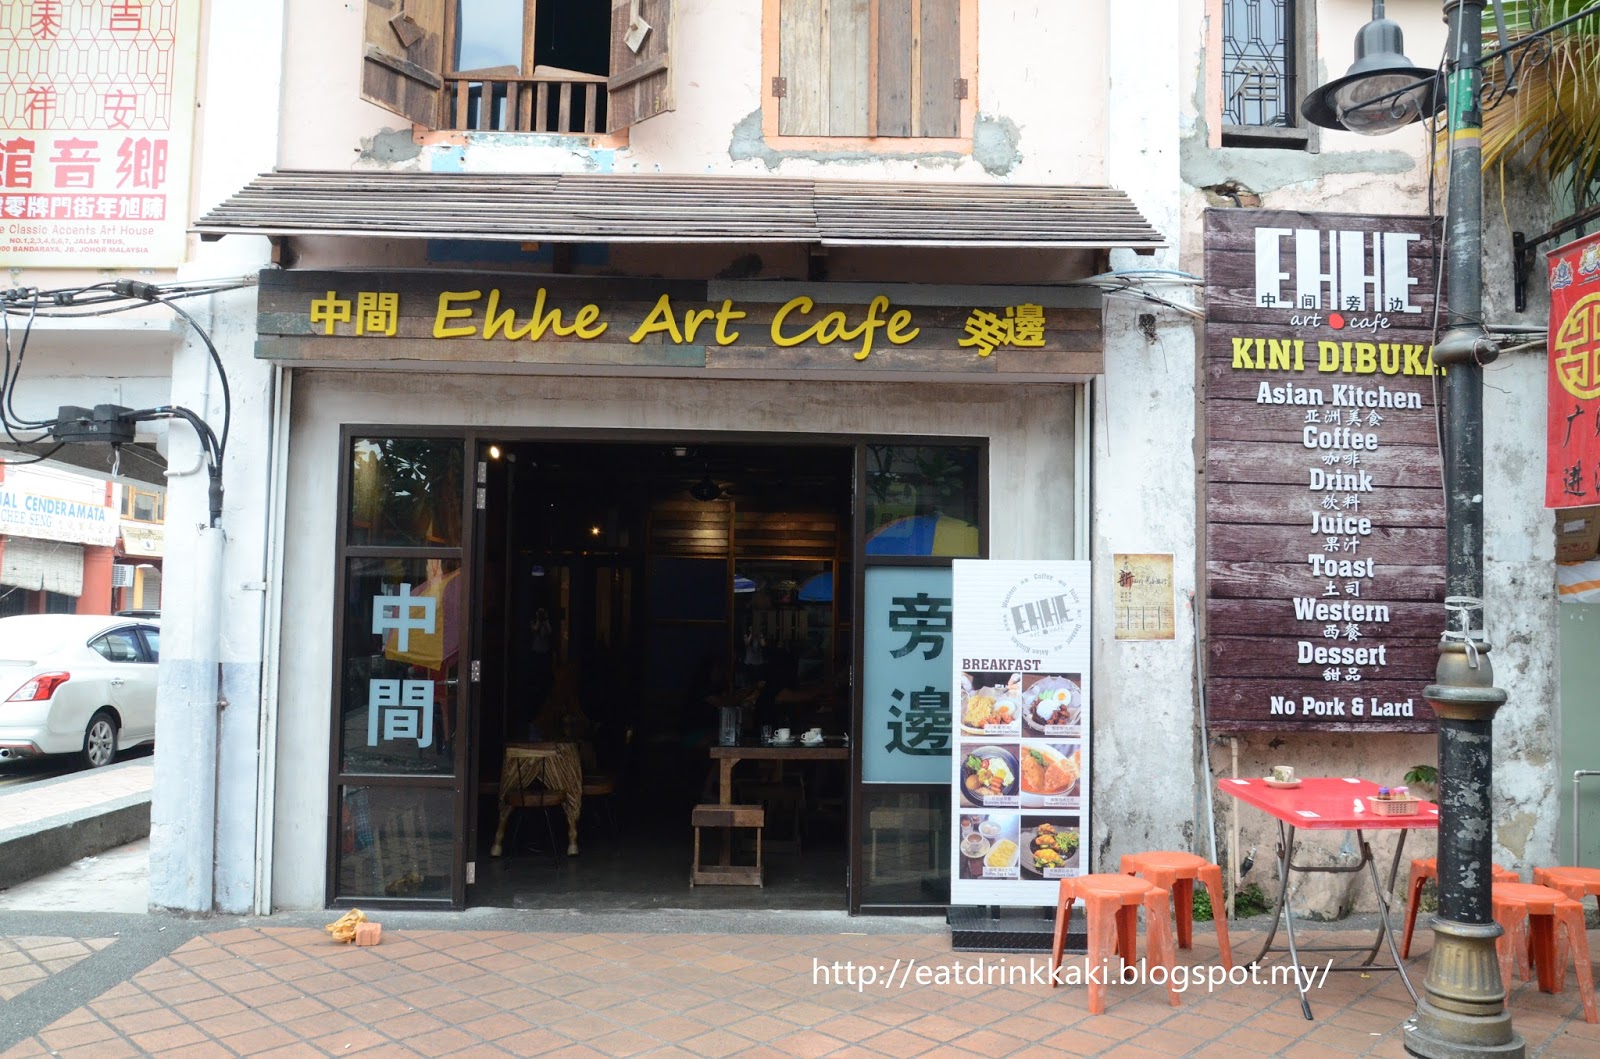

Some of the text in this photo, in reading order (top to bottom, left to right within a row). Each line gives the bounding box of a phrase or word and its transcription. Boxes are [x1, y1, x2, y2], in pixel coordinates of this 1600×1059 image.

[104, 89, 138, 129] 安
[9, 223, 48, 235] Classic
[52, 224, 97, 236] Accents
[100, 225, 117, 236] Art
[120, 225, 154, 237] House
[102, 239, 125, 247] TRUS,
[1254, 227, 1422, 314] EHHE
[310, 290, 399, 337] 中間
[432, 287, 920, 361] Ehhe Art Cafe
[1290, 312, 1391, 333] art cafe
[957, 303, 1046, 358] 旁邊
[1231, 337, 1305, 371] KINI
[1256, 381, 1423, 410] Asian Kitchen
[1303, 409, 1384, 427] 亚洲美食
[1303, 426, 1379, 449] Coffee
[1321, 452, 1360, 469] 咖啡
[1309, 468, 1373, 492] Drink
[25, 495, 105, 521] CENDERAMATA
[1321, 494, 1360, 511] 饮料
[1, 508, 26, 524] CHEE
[29, 513, 53, 528] SENG
[1310, 511, 1372, 535] Juice
[1322, 536, 1360, 554] 果汁
[1308, 553, 1375, 578] Toast
[1322, 580, 1360, 597] 土司
[1293, 598, 1390, 622] Western
[1322, 623, 1363, 641] 西餐
[962, 658, 1041, 671] BREAKFAST
[1297, 641, 1387, 665] Dessert
[367, 582, 437, 749] 中間
[1322, 667, 1361, 682] 甜品
[1270, 696, 1414, 717] No Pork & Lard
